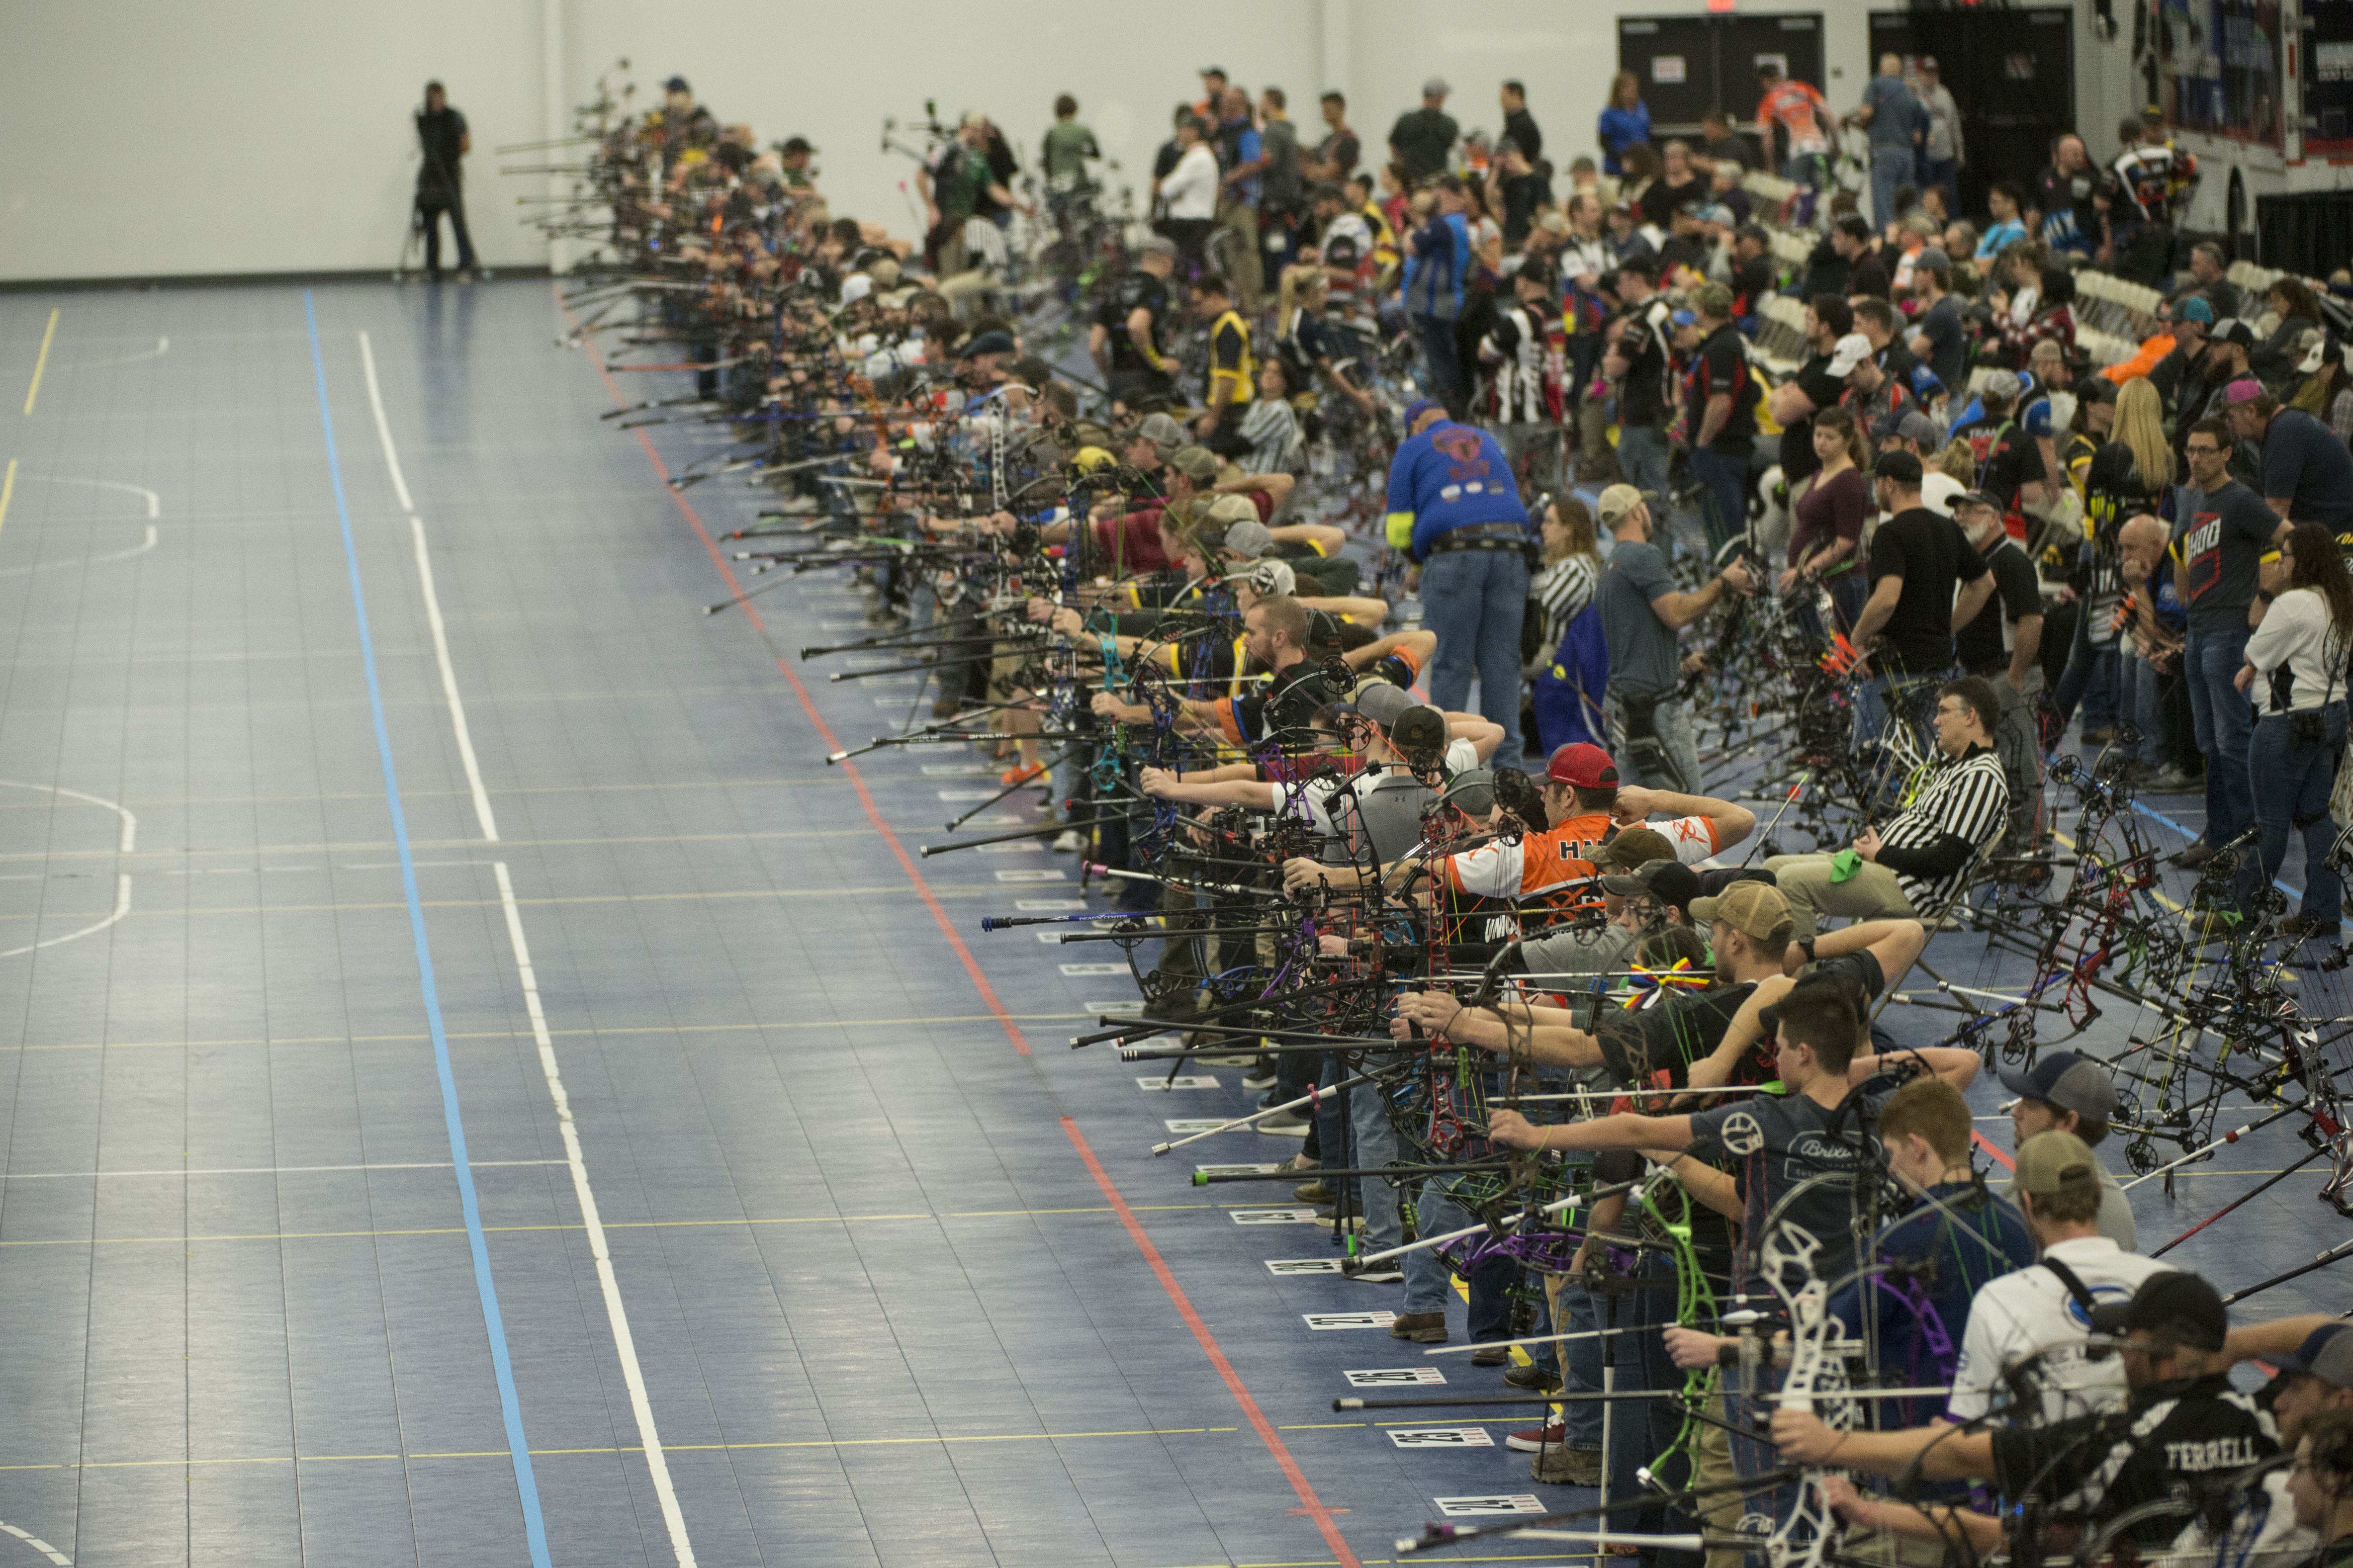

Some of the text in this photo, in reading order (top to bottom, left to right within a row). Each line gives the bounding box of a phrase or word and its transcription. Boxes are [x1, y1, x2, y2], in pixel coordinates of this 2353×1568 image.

[1271, 1262, 1334, 1271] 28
[1309, 1316, 1374, 1325] 27
[1350, 1372, 1418, 1383] 26
[1394, 1432, 1464, 1443] 25
[2164, 1436, 2261, 1472] TERRELL
[1442, 1499, 1516, 1511] 24
